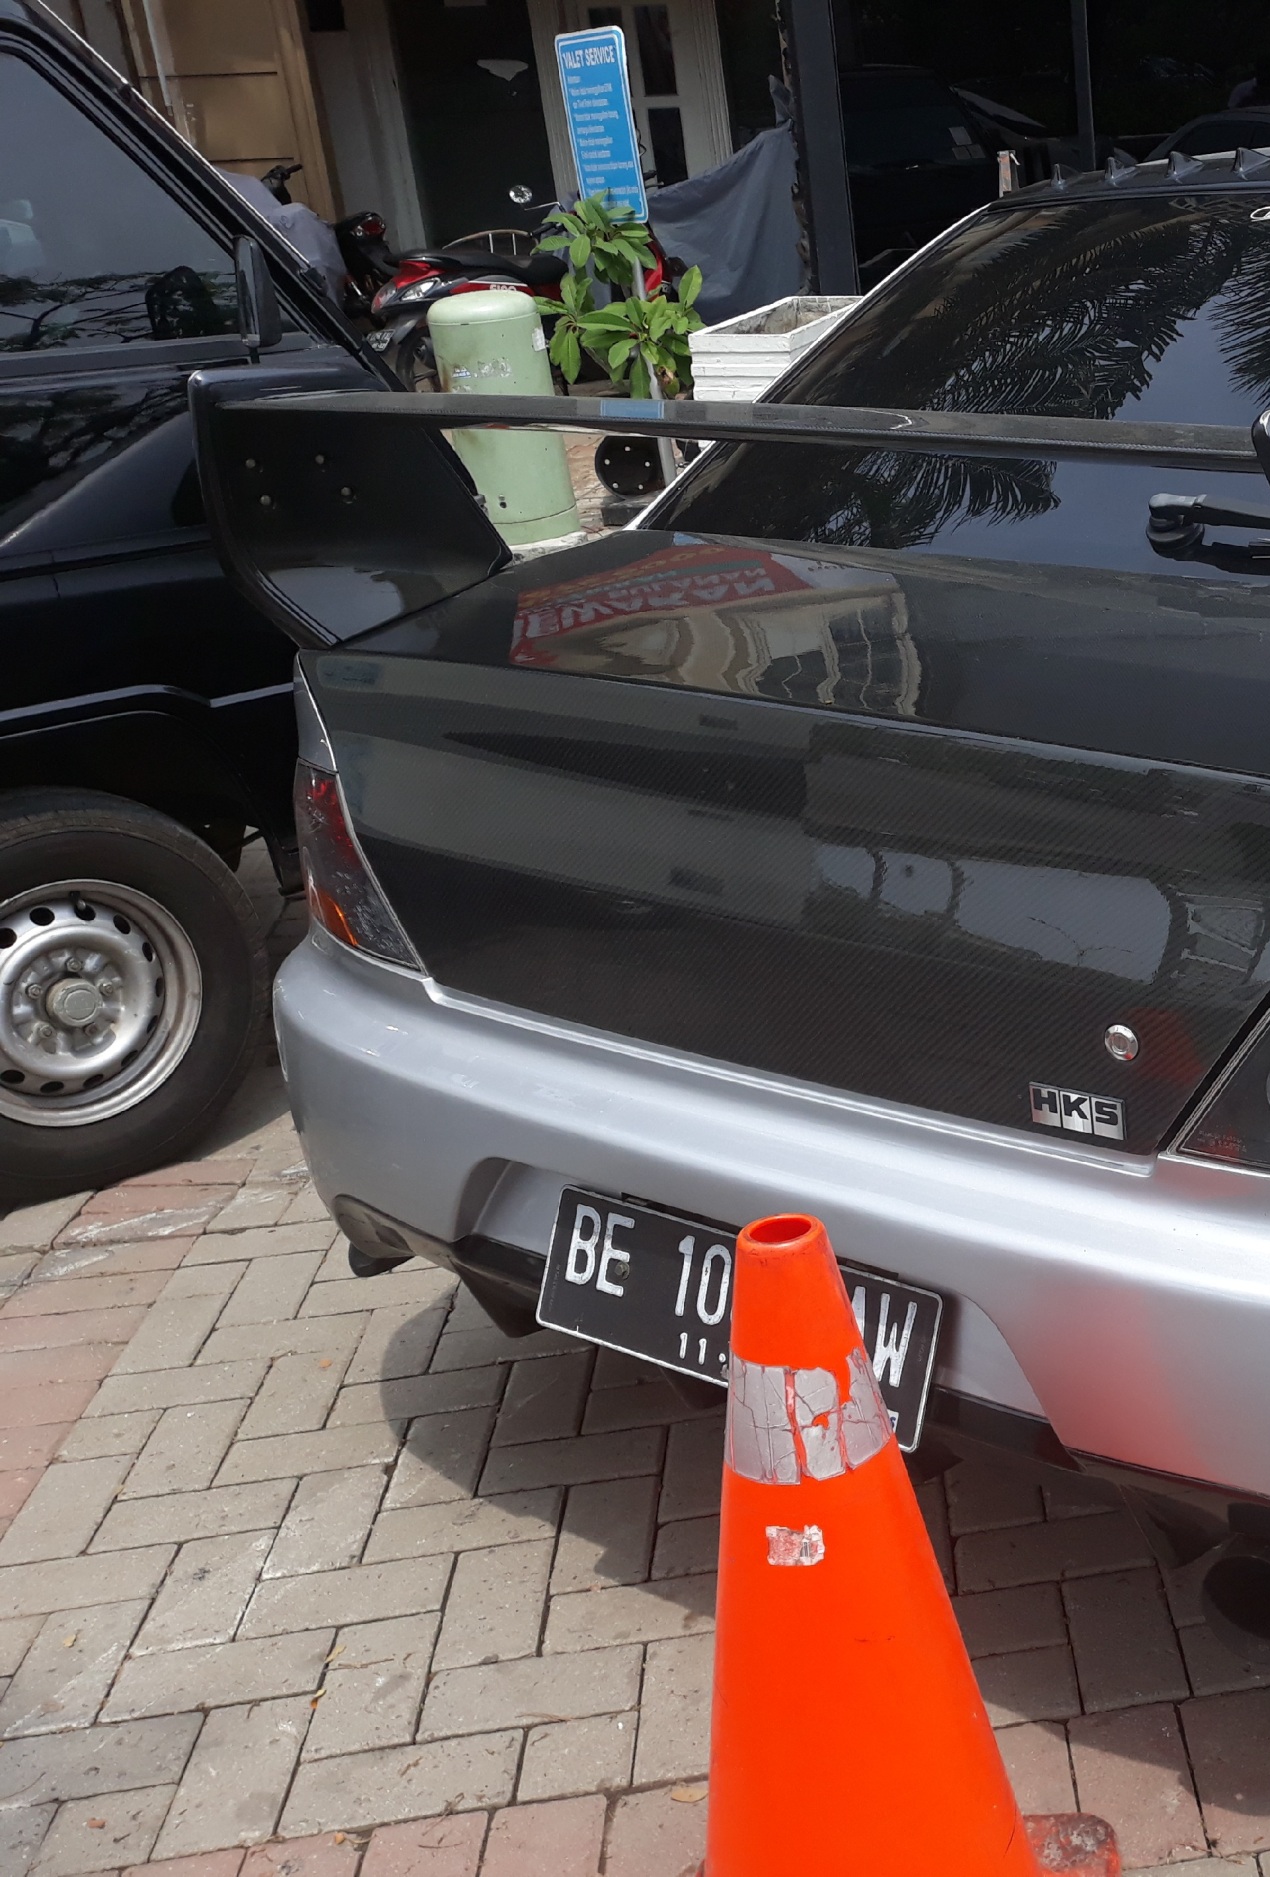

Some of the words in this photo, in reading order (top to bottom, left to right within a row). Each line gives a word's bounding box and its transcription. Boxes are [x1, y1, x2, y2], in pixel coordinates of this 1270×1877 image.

[562, 49, 584, 69] VALET
[585, 45, 615, 66] SERVICE
[1032, 1088, 1118, 1126] HKS
[565, 1203, 635, 1297] BE
